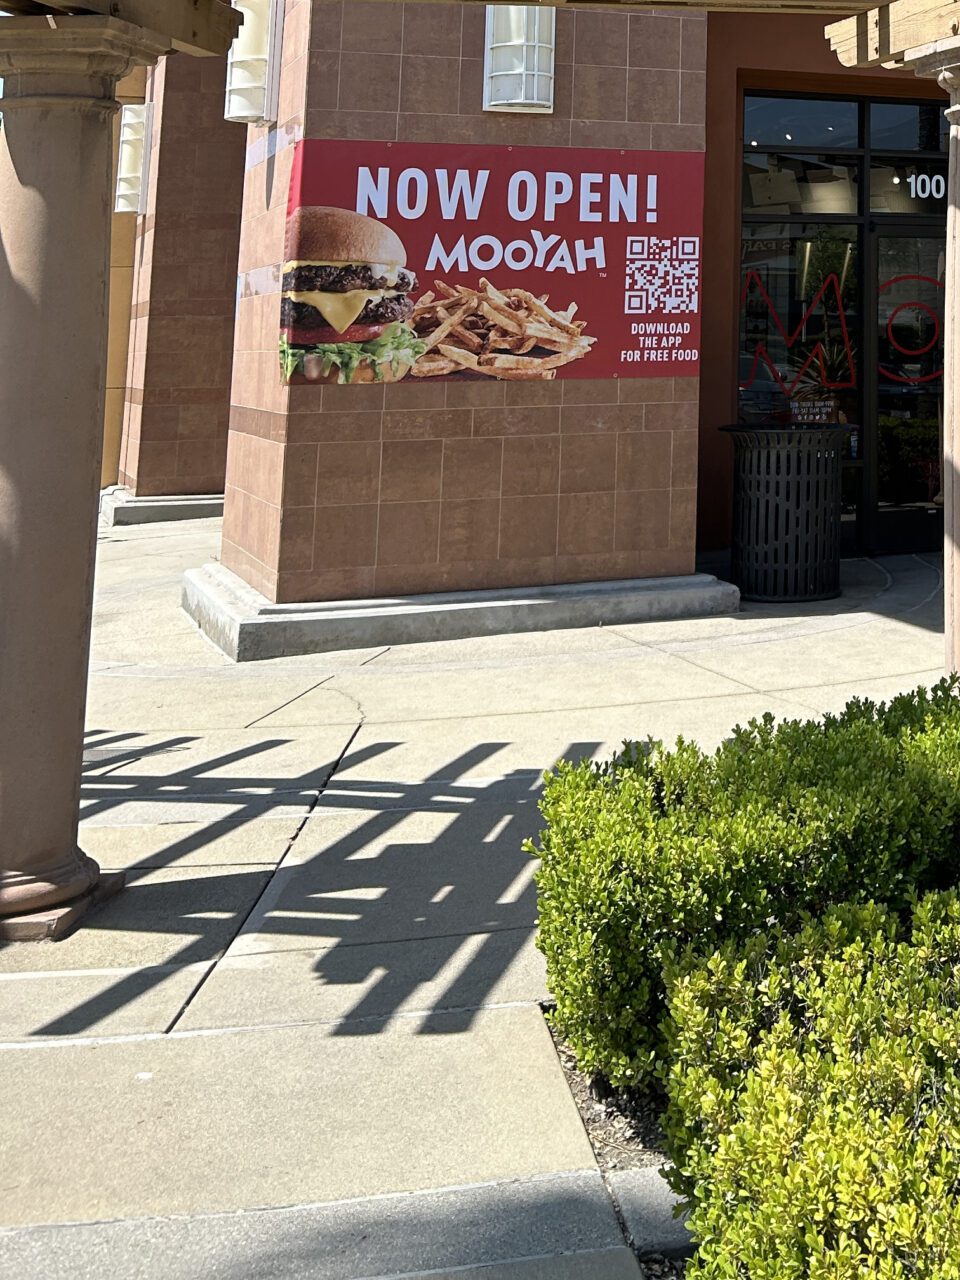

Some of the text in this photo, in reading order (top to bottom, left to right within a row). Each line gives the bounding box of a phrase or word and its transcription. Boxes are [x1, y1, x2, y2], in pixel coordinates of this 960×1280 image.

[356, 166, 658, 224] NOW OPEN!
[906, 174, 945, 199] 100
[424, 229, 606, 274] MOOYAH
[631, 322, 691, 335] DOWNLOAD
[638, 336, 682, 348] THE APP
[620, 349, 699, 362] FOR FREE FOOD
